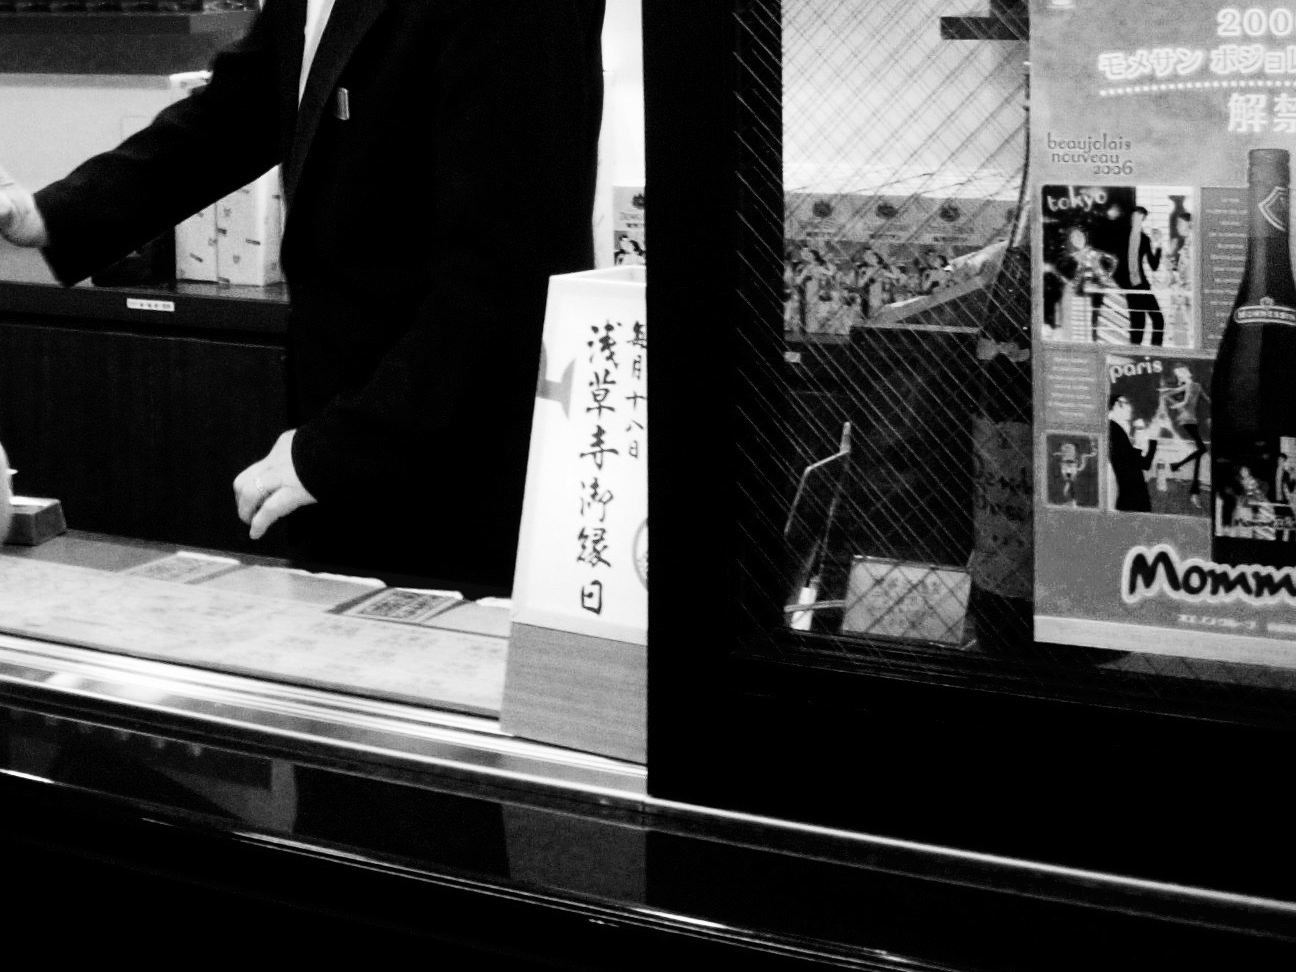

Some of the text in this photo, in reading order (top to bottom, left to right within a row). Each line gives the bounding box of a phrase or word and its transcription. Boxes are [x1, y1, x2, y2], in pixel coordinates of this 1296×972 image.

[1047, 133, 1132, 153] beaujolais
[1051, 152, 1120, 164] nouveau
[1093, 160, 1133, 175] 2006
[1046, 186, 1108, 212] tokyo
[1109, 356, 1163, 383] paris
[577, 320, 622, 616] 浅草寺御縁日
